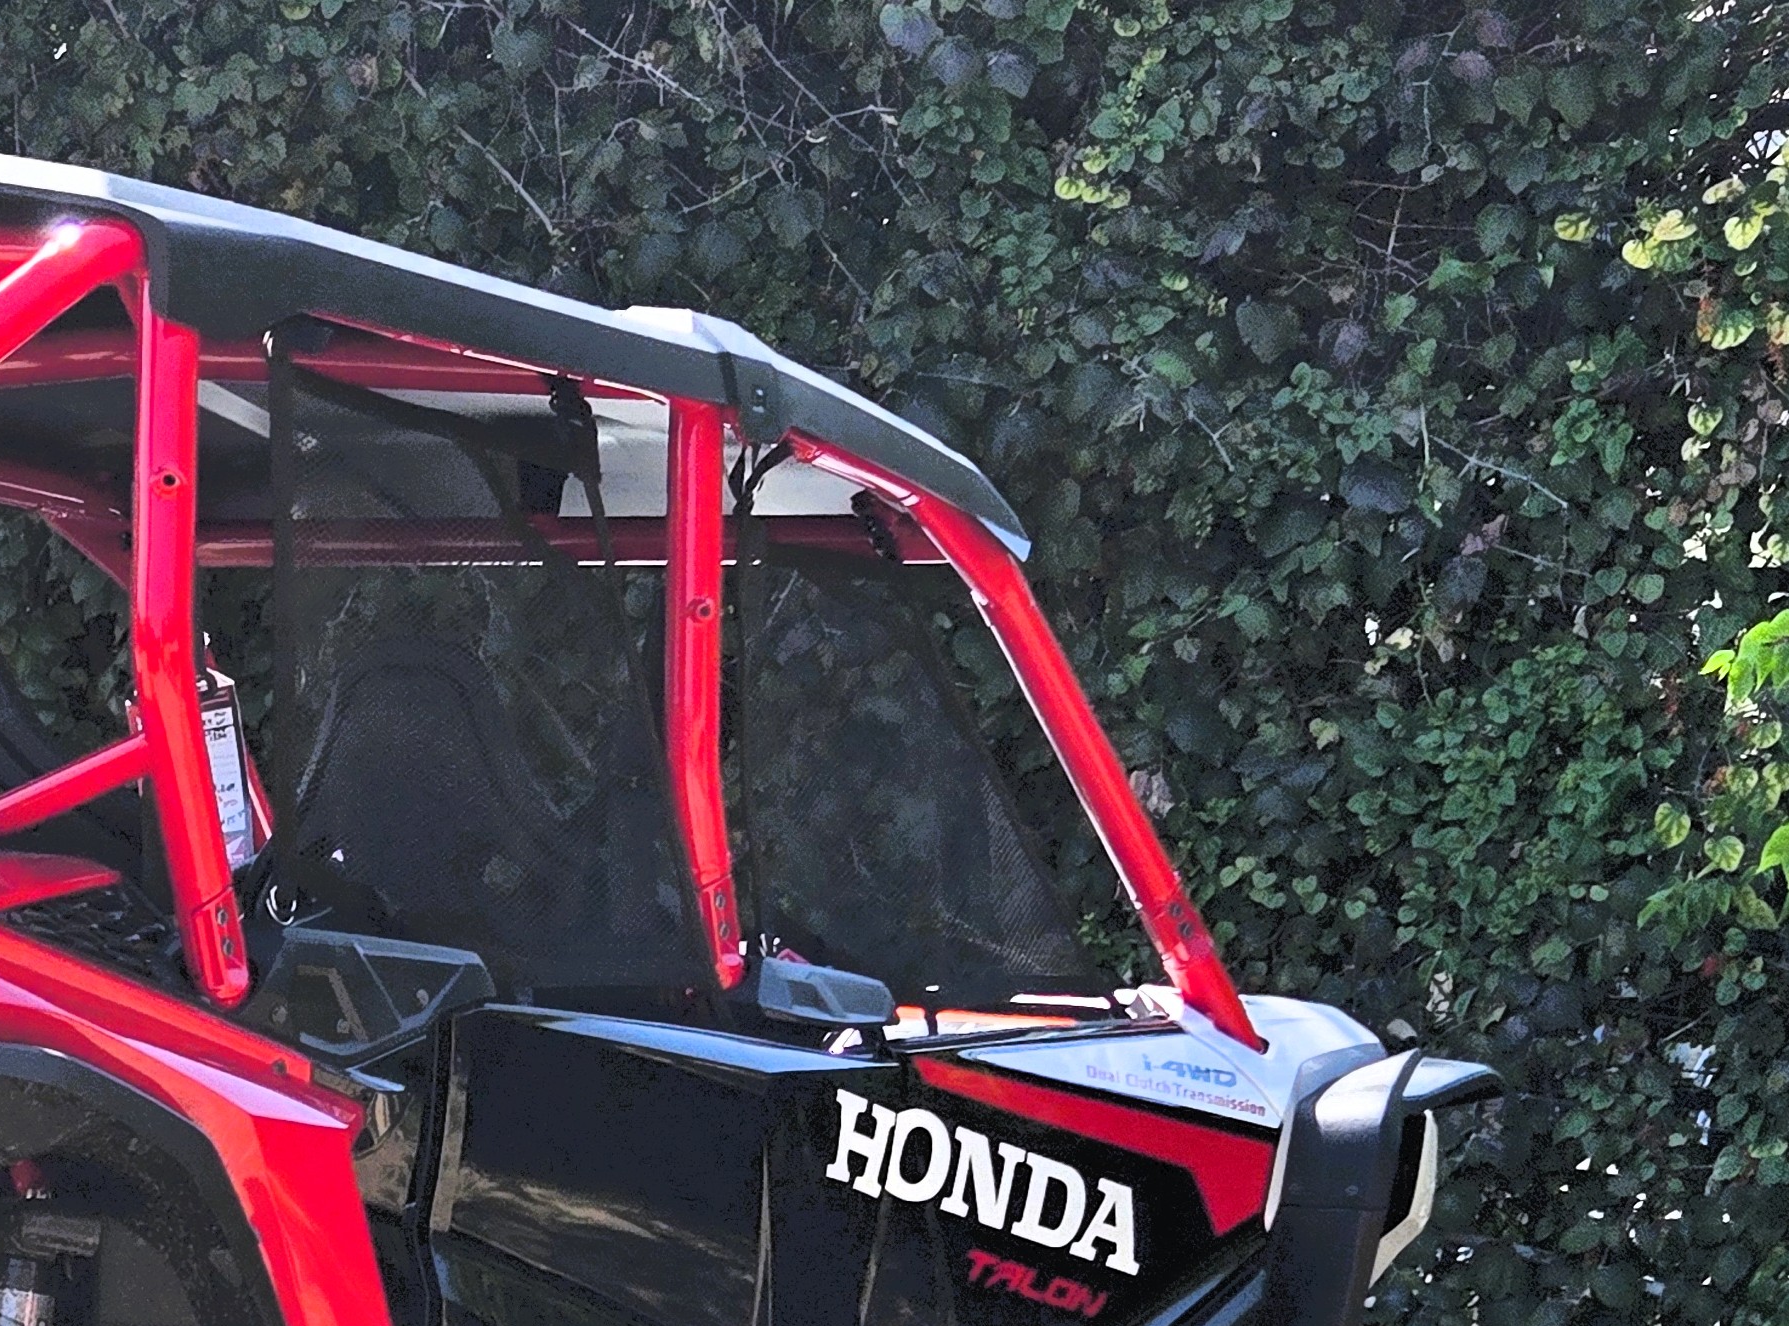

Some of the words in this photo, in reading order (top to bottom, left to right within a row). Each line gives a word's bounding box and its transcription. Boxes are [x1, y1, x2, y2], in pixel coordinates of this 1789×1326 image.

[1086, 1064, 1121, 1084] Dual
[1125, 1072, 1171, 1095] Clutch
[1172, 1082, 1267, 1117] Transmission
[1141, 1053, 1237, 1088] i-4WD
[825, 1088, 1140, 1276] HONDA
[967, 1248, 1109, 1319] TALON
